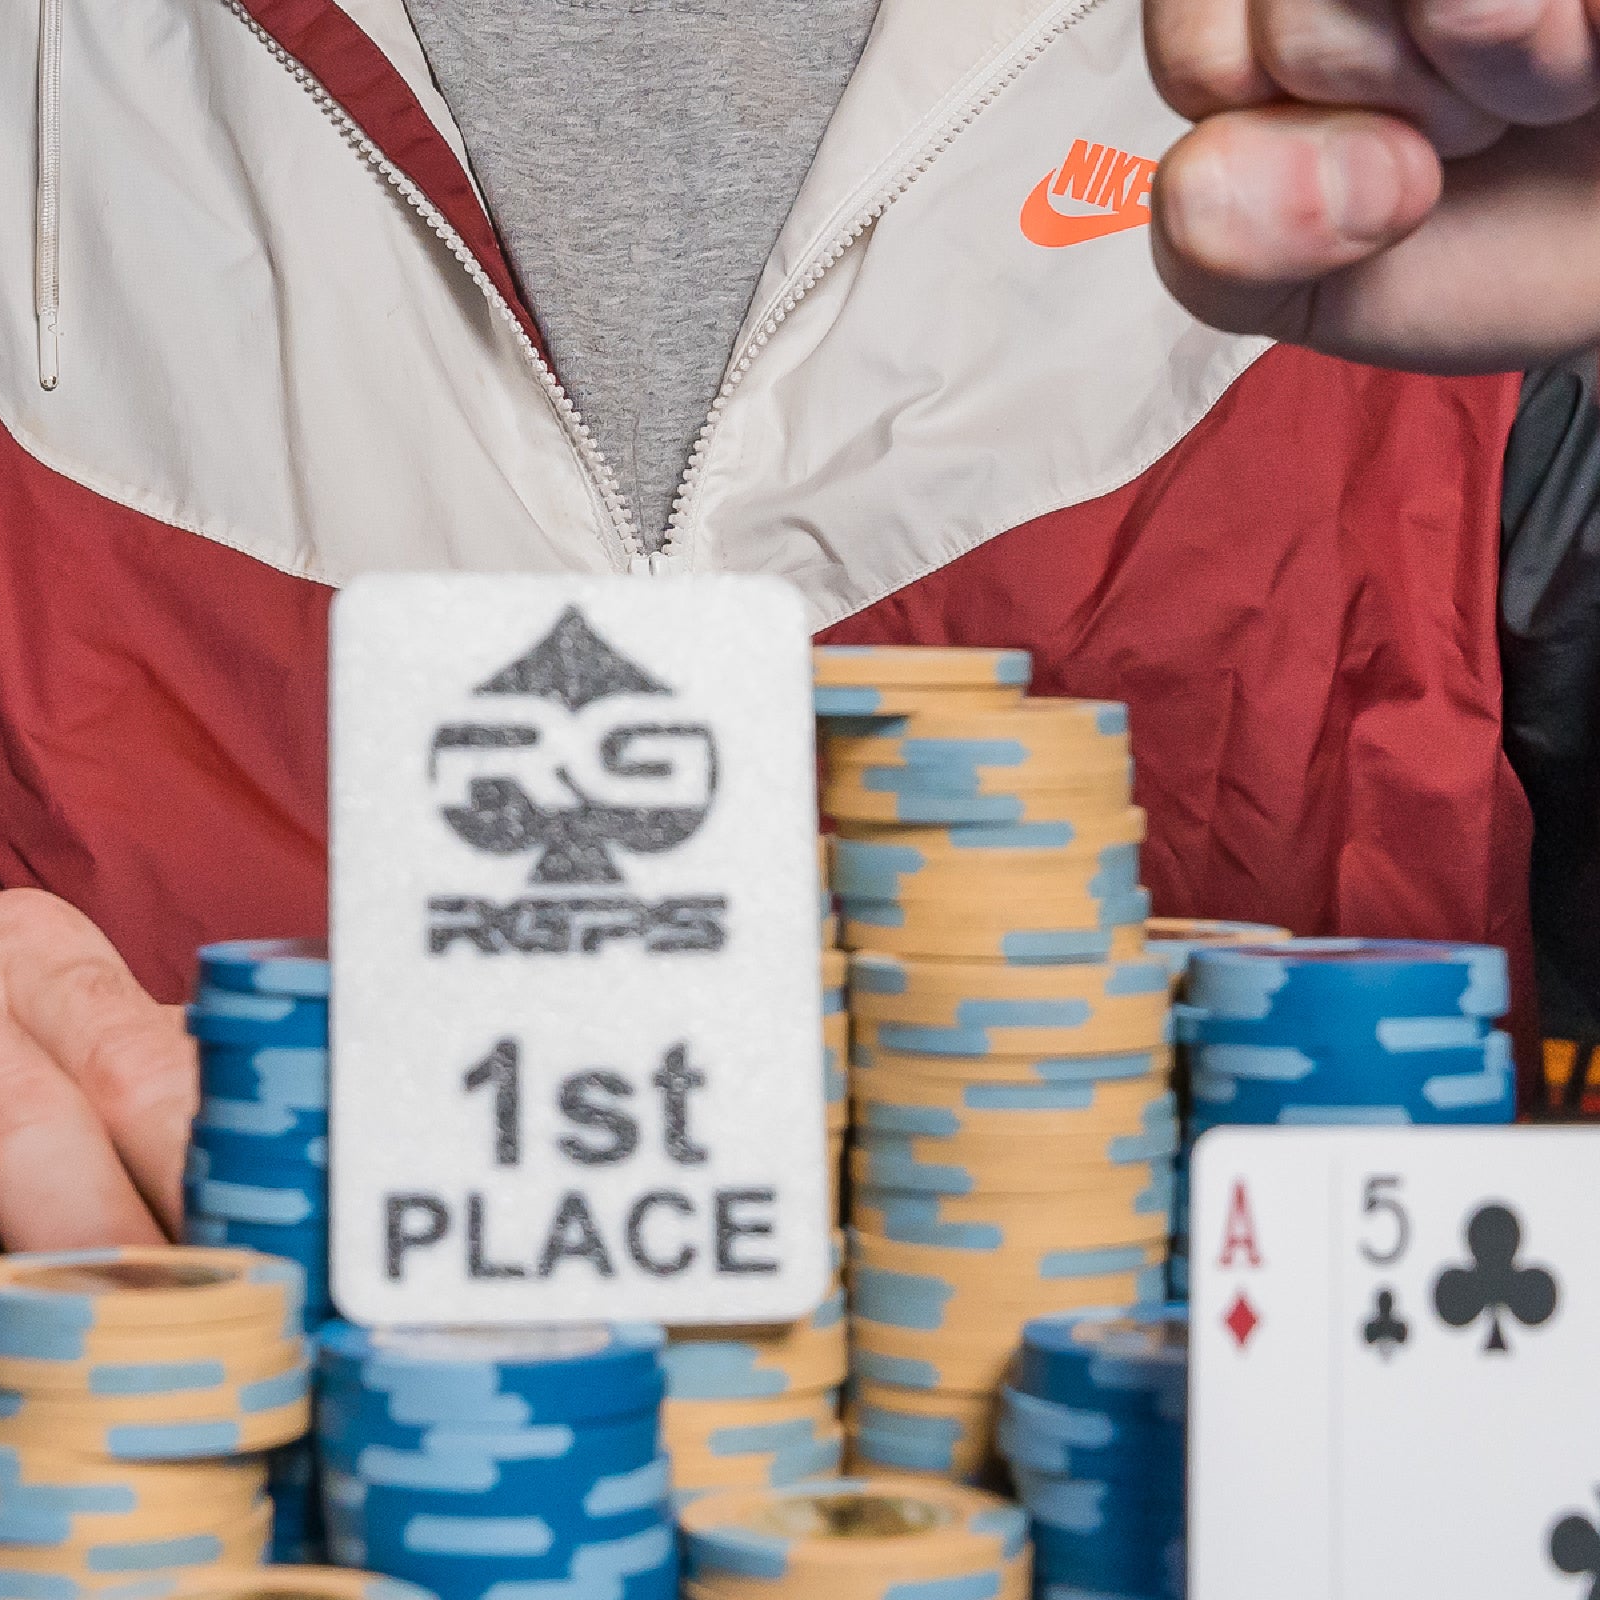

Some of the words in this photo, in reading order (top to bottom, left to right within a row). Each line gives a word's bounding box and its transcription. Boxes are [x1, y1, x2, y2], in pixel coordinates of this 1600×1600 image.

[1051, 138, 1160, 215] NIKE
[426, 896, 726, 952] RGPS
[462, 1038, 708, 1168] 1st
[383, 1187, 778, 1282] PLACE
[1218, 1179, 1262, 1270] A
[1359, 1175, 1411, 1267] 5
